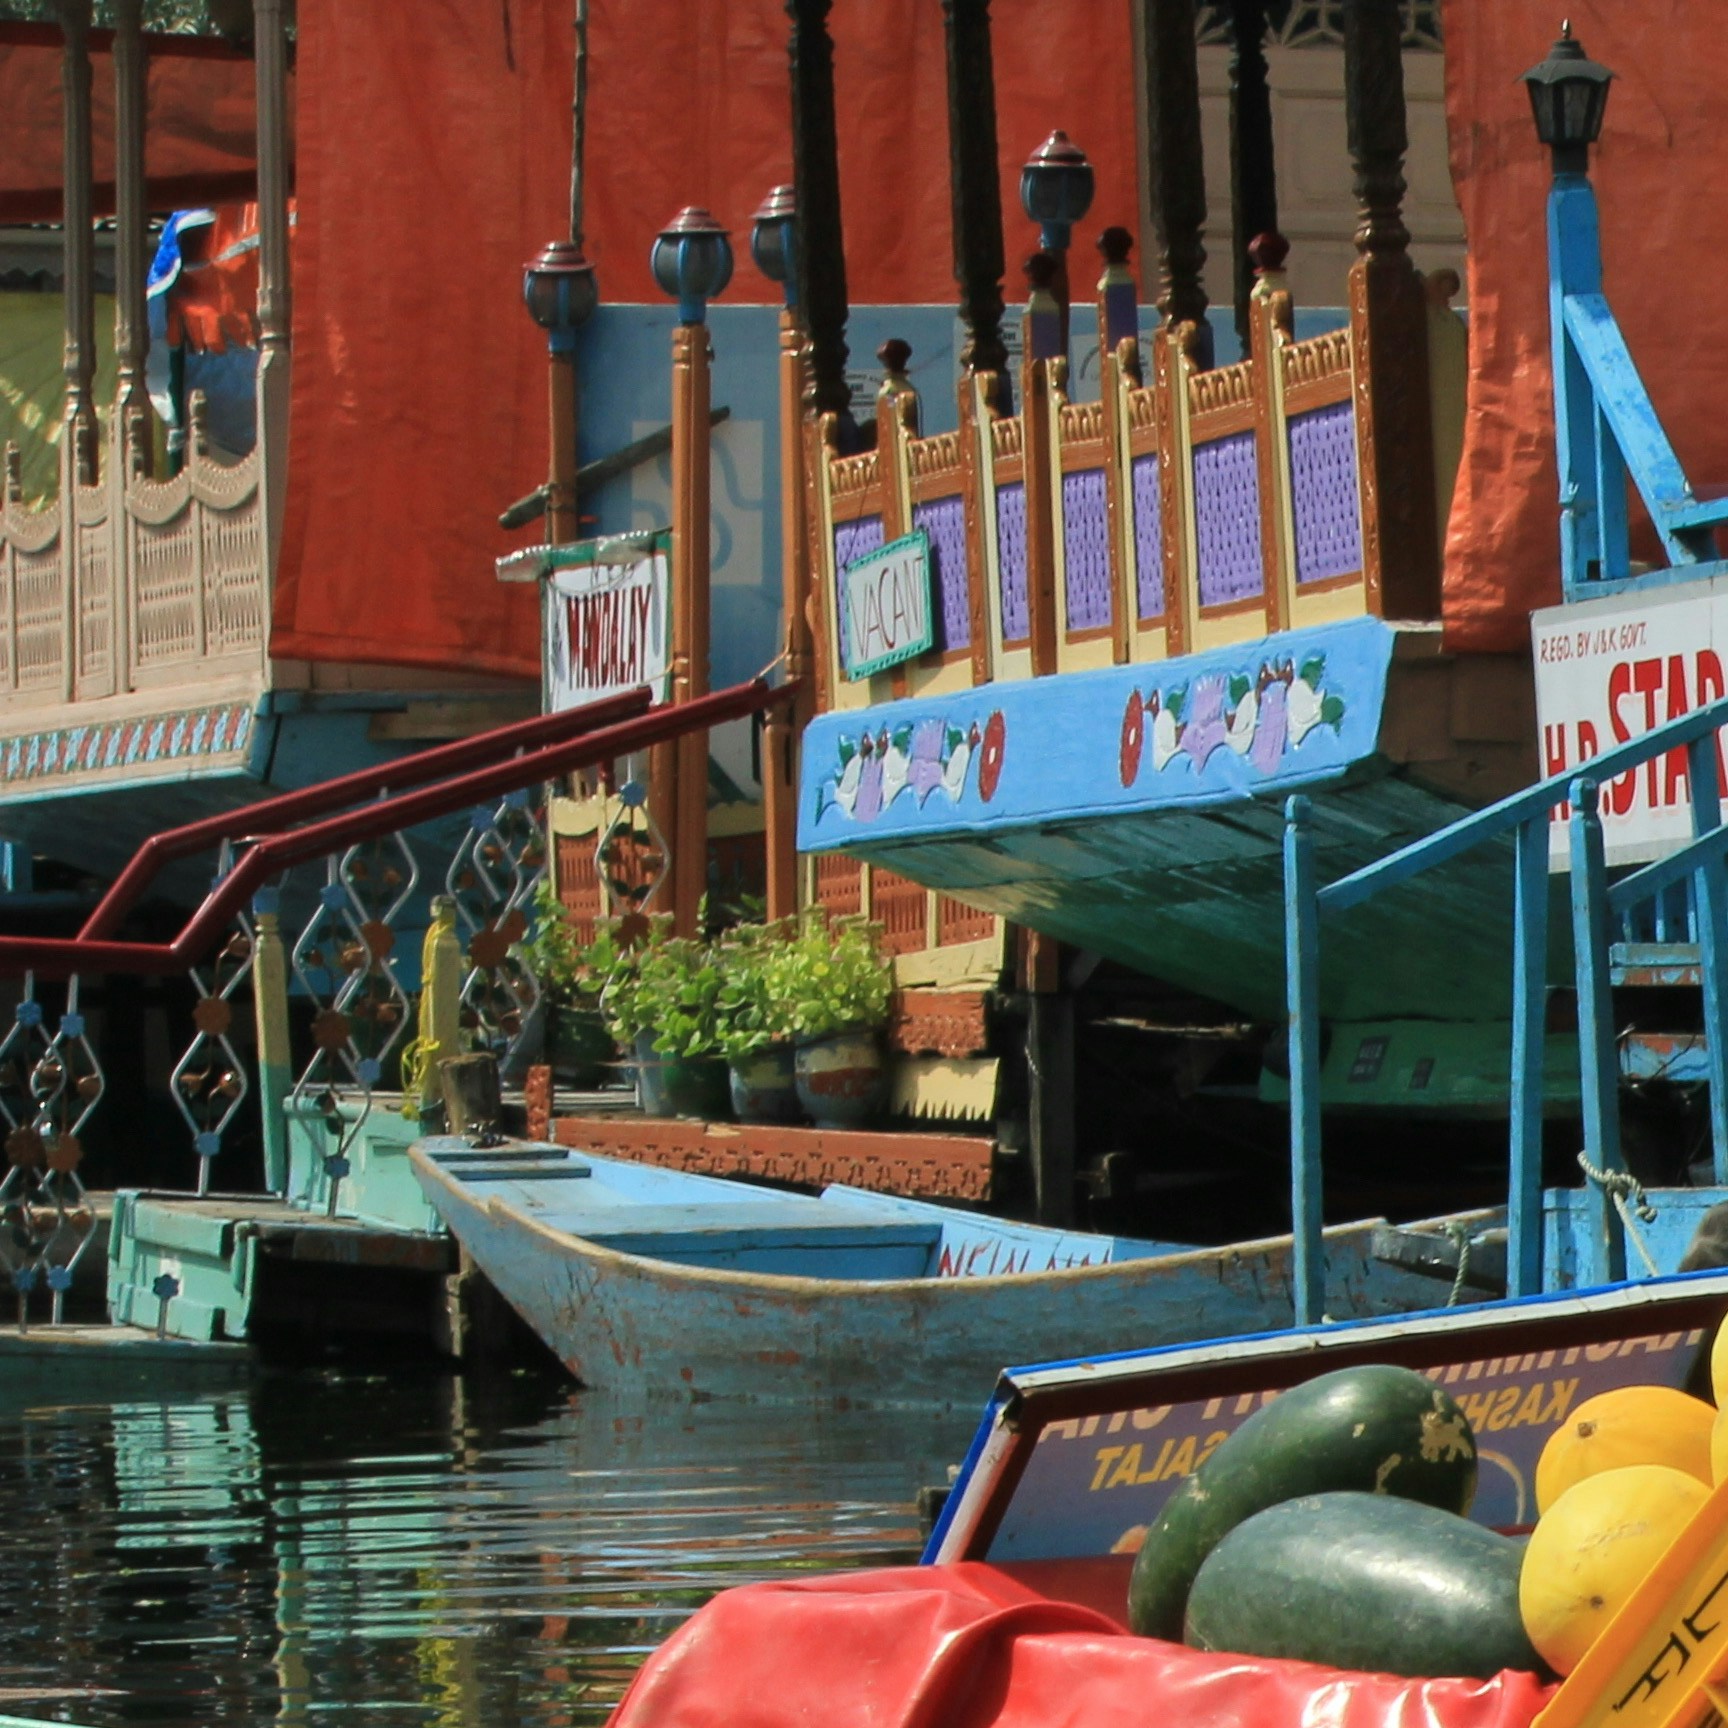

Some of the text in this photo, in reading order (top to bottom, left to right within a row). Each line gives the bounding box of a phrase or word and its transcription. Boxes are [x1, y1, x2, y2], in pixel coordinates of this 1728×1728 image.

[566, 583, 652, 691] MANDALAY
[848, 555, 925, 661] VACANT
[1576, 631, 1591, 658] BY
